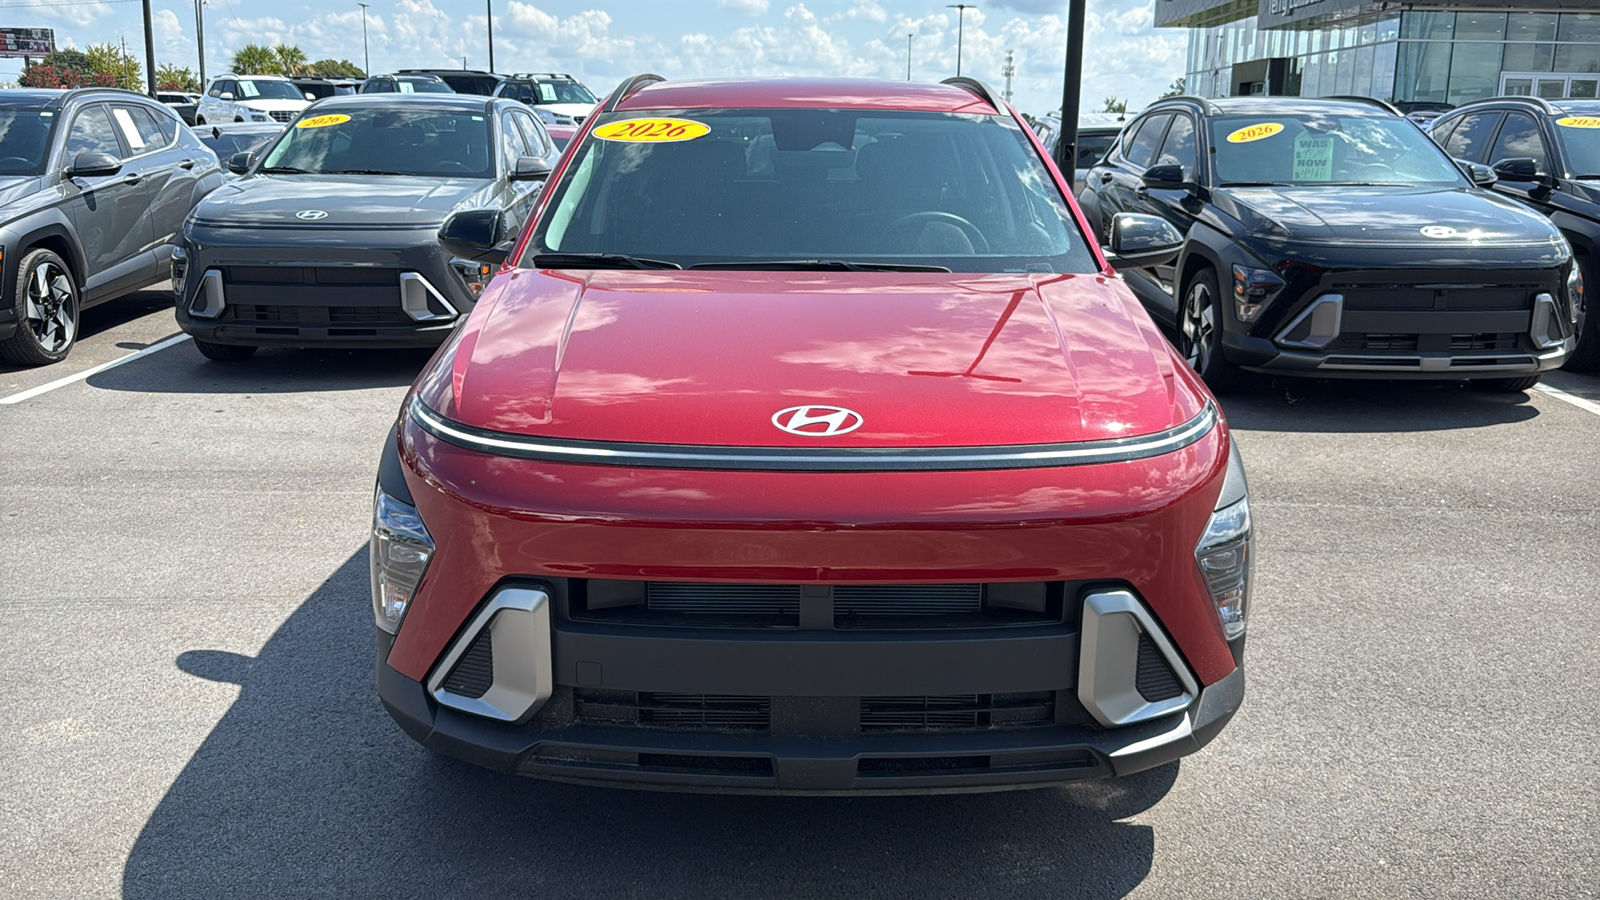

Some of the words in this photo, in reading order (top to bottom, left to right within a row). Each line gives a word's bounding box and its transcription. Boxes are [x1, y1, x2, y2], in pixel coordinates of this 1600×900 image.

[303, 116, 341, 127] 2026
[607, 122, 695, 138] 2026
[1238, 125, 1273, 141] 2026
[1299, 140, 1328, 148] WAS
[1297, 159, 1328, 167] NOW
